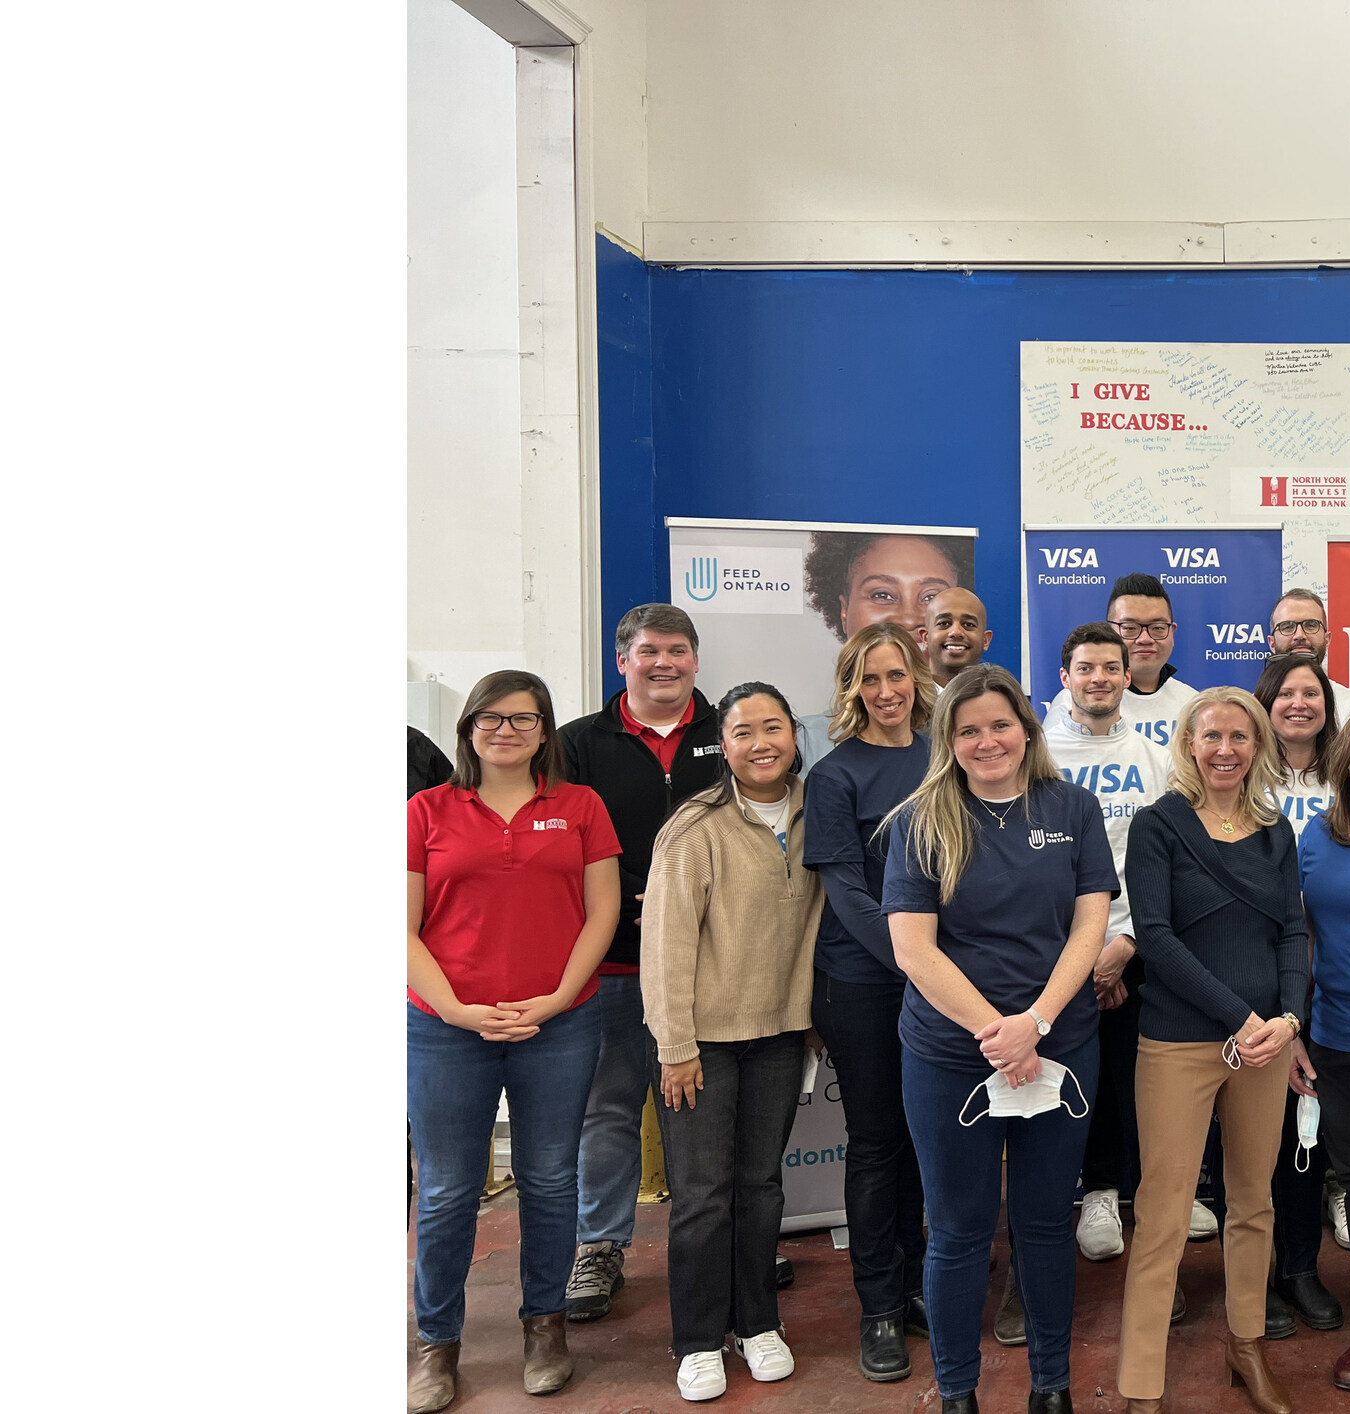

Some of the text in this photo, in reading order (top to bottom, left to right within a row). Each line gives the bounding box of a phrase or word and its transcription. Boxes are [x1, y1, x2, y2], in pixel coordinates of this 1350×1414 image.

[1122, 348, 1147, 358] together
[1047, 356, 1074, 366] to build
[1169, 373, 1189, 388] Thanks
[1070, 383, 1079, 398] I
[1094, 383, 1150, 400] GIVE
[1080, 412, 1208, 431] BECAUSE...
[1170, 475, 1195, 483] hungry
[1107, 488, 1125, 502] care
[1127, 476, 1142, 489] very
[1039, 548, 1099, 568] VISA
[1161, 548, 1220, 568] VISA
[723, 569, 761, 579] FEED
[1038, 573, 1105, 584] Foundation
[1160, 573, 1226, 584] Foundation
[723, 581, 790, 592] ONTARIO
[1206, 624, 1265, 643] VISA
[1206, 649, 1271, 660] Foundation
[1057, 764, 1144, 795] VISA
